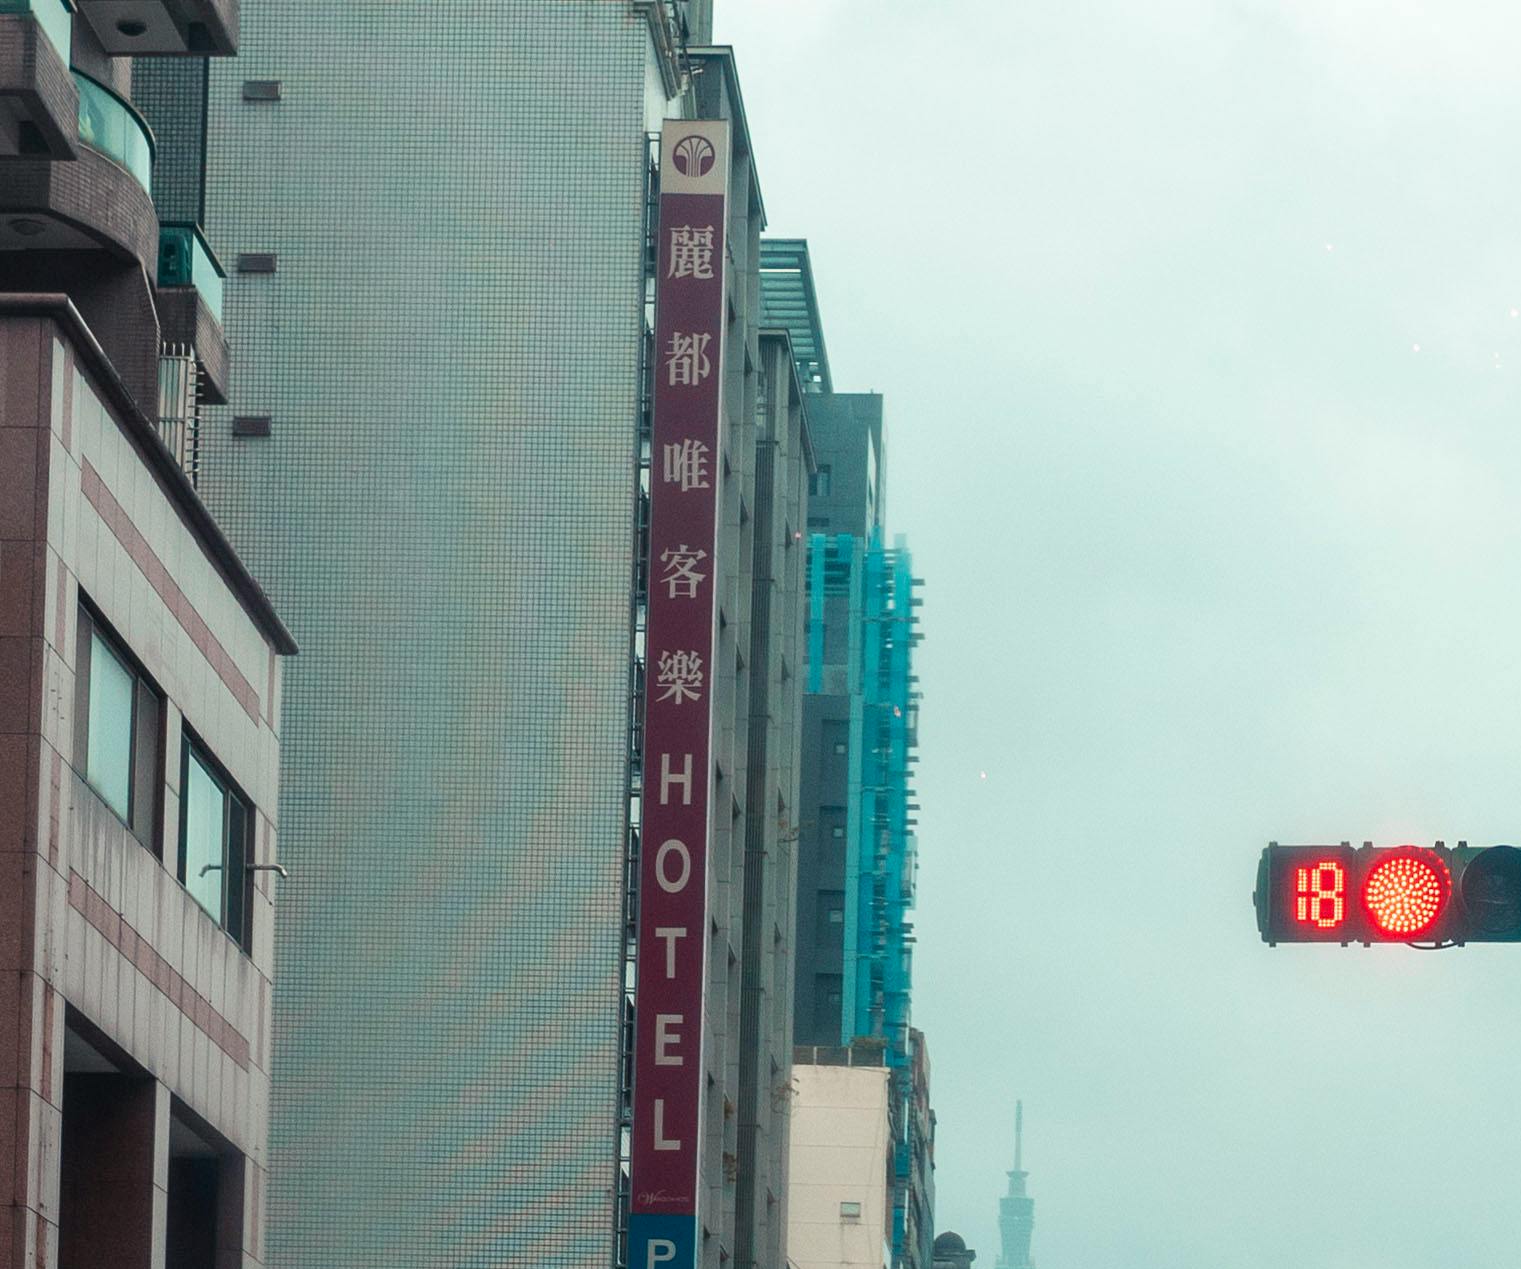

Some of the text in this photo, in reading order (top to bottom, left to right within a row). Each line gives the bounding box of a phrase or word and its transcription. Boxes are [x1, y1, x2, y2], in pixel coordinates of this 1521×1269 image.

[655, 225, 715, 705] 麗都唯客樂
[653, 752, 692, 1151] HOTEL
[1296, 862, 1345, 928] 18
